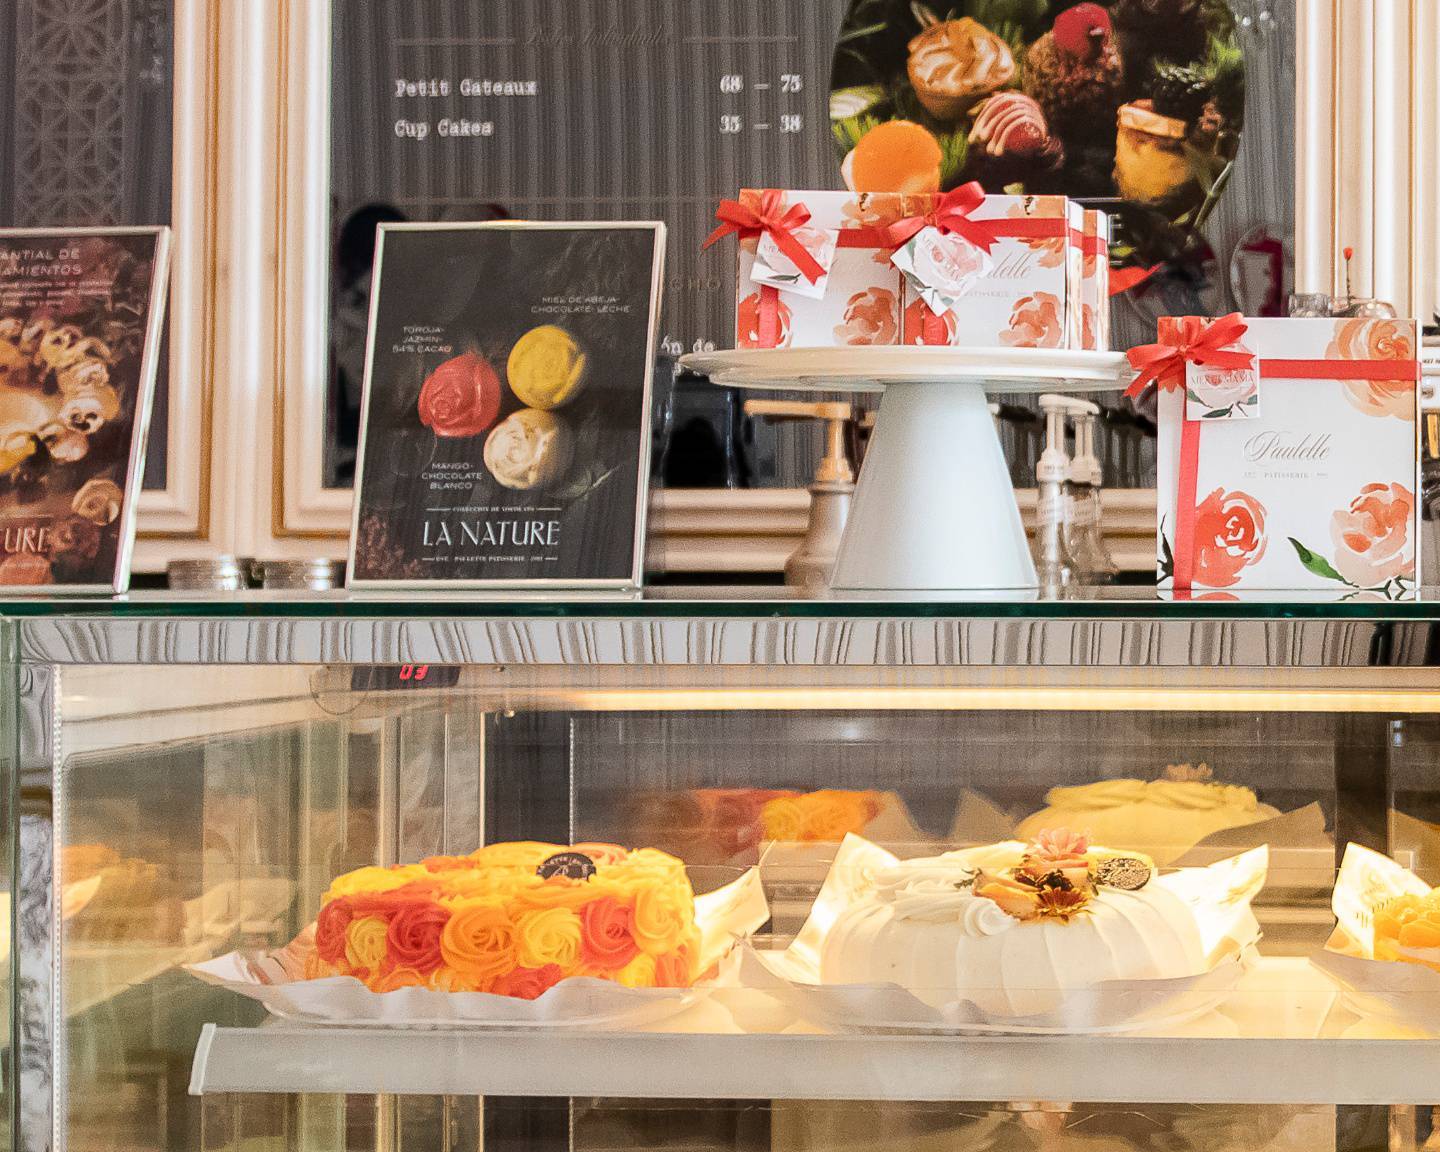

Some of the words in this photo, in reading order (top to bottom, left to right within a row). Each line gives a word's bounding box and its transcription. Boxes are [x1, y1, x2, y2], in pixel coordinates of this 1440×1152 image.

[395, 79, 450, 96] Petit
[460, 79, 538, 96] Gateaux
[395, 119, 428, 140] Cup
[438, 119, 494, 137] Cakes
[59, 248, 80, 260] DE
[421, 472, 483, 481] CHOCOLATE
[429, 481, 473, 490] BLANCO
[422, 520, 452, 546] LA
[460, 520, 560, 546] NATURE
